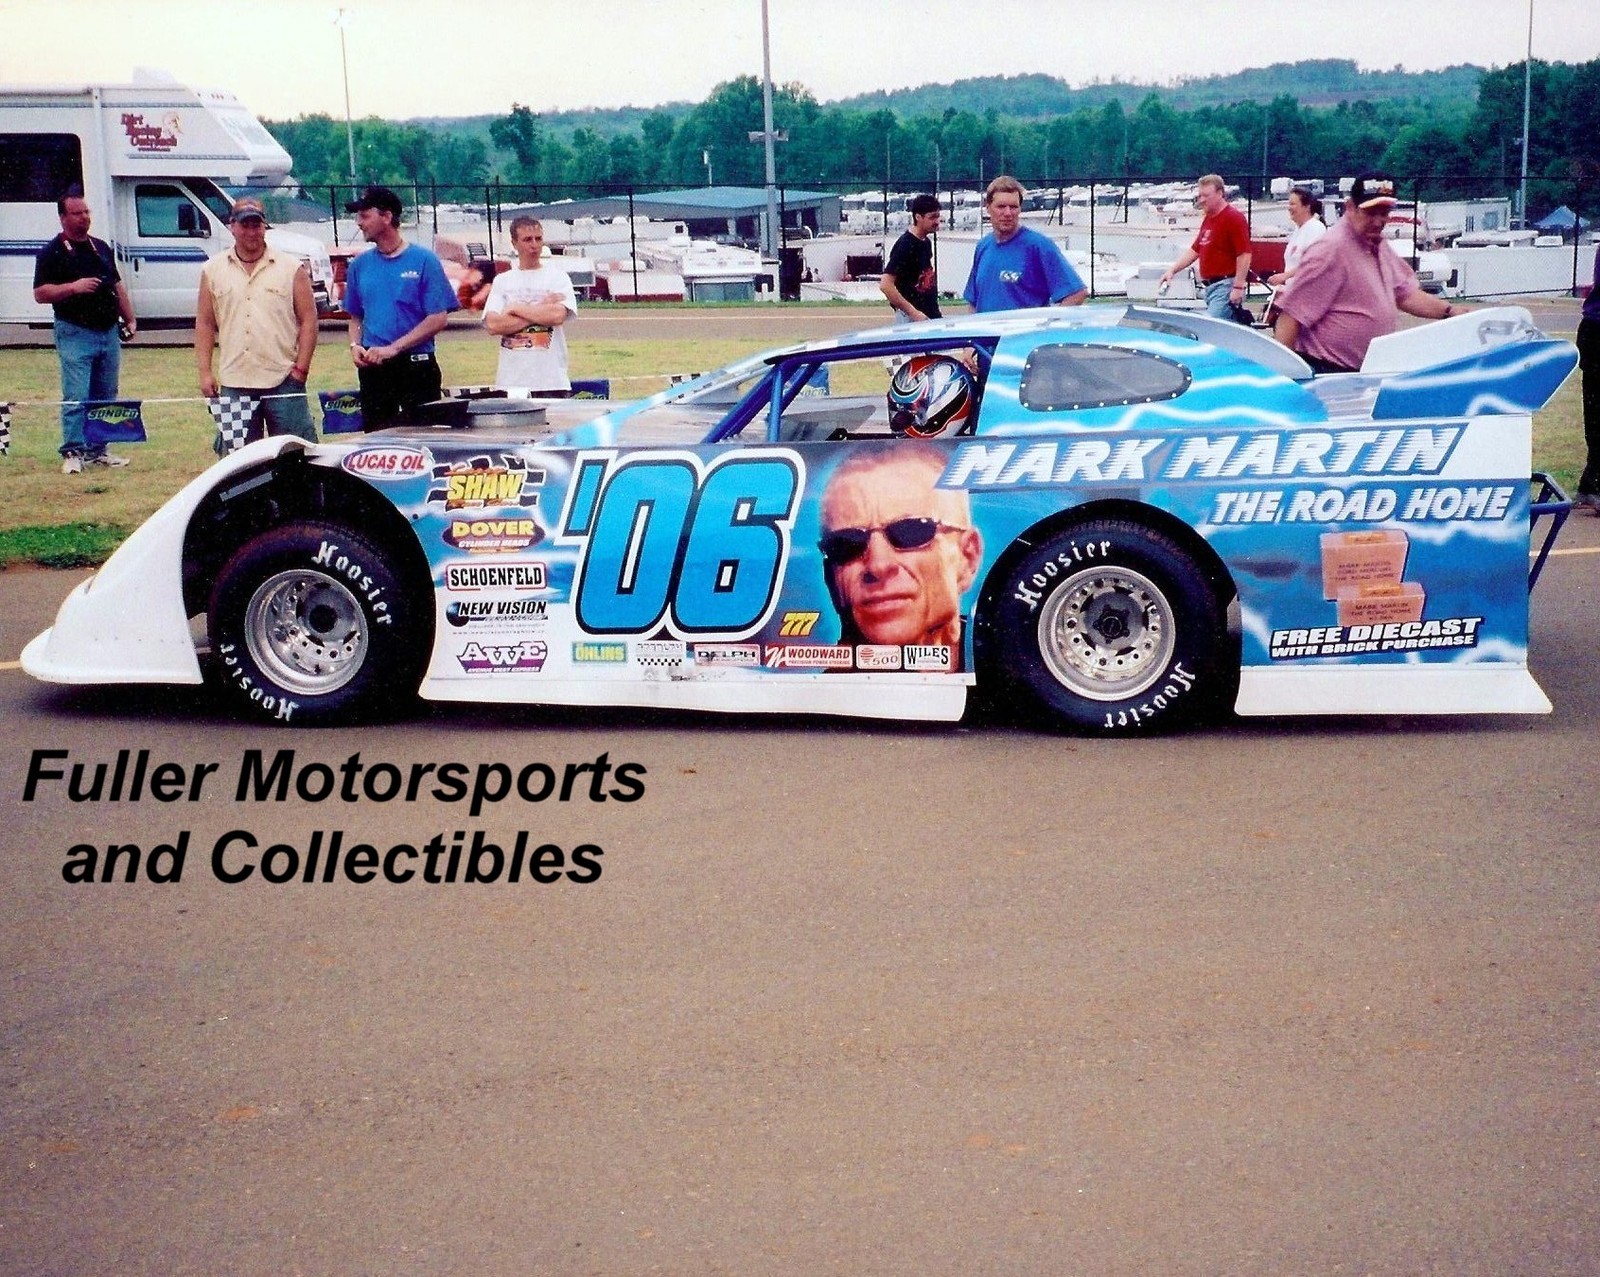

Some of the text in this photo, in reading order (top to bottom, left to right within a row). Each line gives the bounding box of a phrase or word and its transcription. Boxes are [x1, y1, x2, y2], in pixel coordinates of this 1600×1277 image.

[88, 409, 138, 419] SUNOCO
[347, 455, 424, 469] LUCAS OIL
[944, 428, 1460, 486] MARK MARTIN
[448, 474, 522, 500] SHAW
[1211, 487, 1514, 523] THE ROAD HOME
[452, 521, 534, 537] DOVER
[311, 541, 392, 625] Hoosier
[450, 567, 542, 587] SCHOENFELD
[1015, 540, 1110, 611] Hoosier
[460, 601, 547, 615] NEW VISION
[780, 612, 820, 636] 777
[1272, 618, 1481, 646] FREE DIECAST
[457, 641, 548, 666] AWE
[788, 648, 850, 659] WOODWARD
[906, 647, 949, 665] WILES
[1272, 635, 1474, 657] WITH BRICK PURCHASE
[872, 655, 898, 665] 500
[220, 643, 299, 721] Hoosier
[1104, 662, 1195, 728] Hoosier
